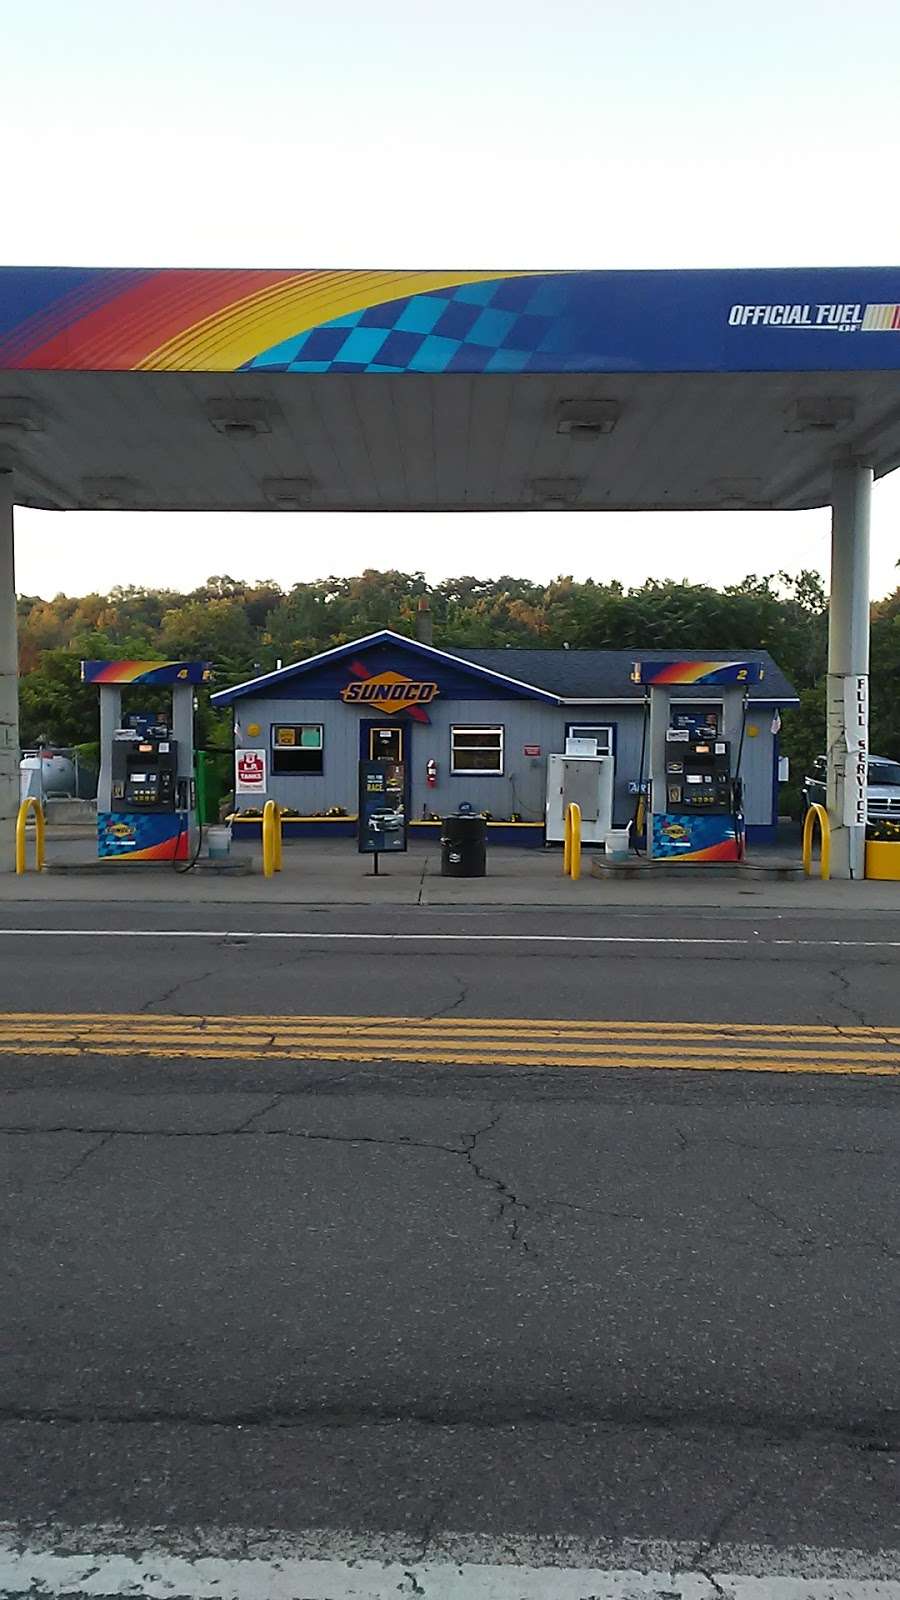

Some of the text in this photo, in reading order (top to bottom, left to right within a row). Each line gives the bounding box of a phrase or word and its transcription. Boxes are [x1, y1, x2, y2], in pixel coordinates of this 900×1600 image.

[728, 304, 862, 325] OFFICIAL FUEL
[177, 668, 188, 680] 4
[736, 669, 748, 680] 2
[345, 683, 435, 701] SUNOCO
[856, 739, 867, 824] SERVICE
